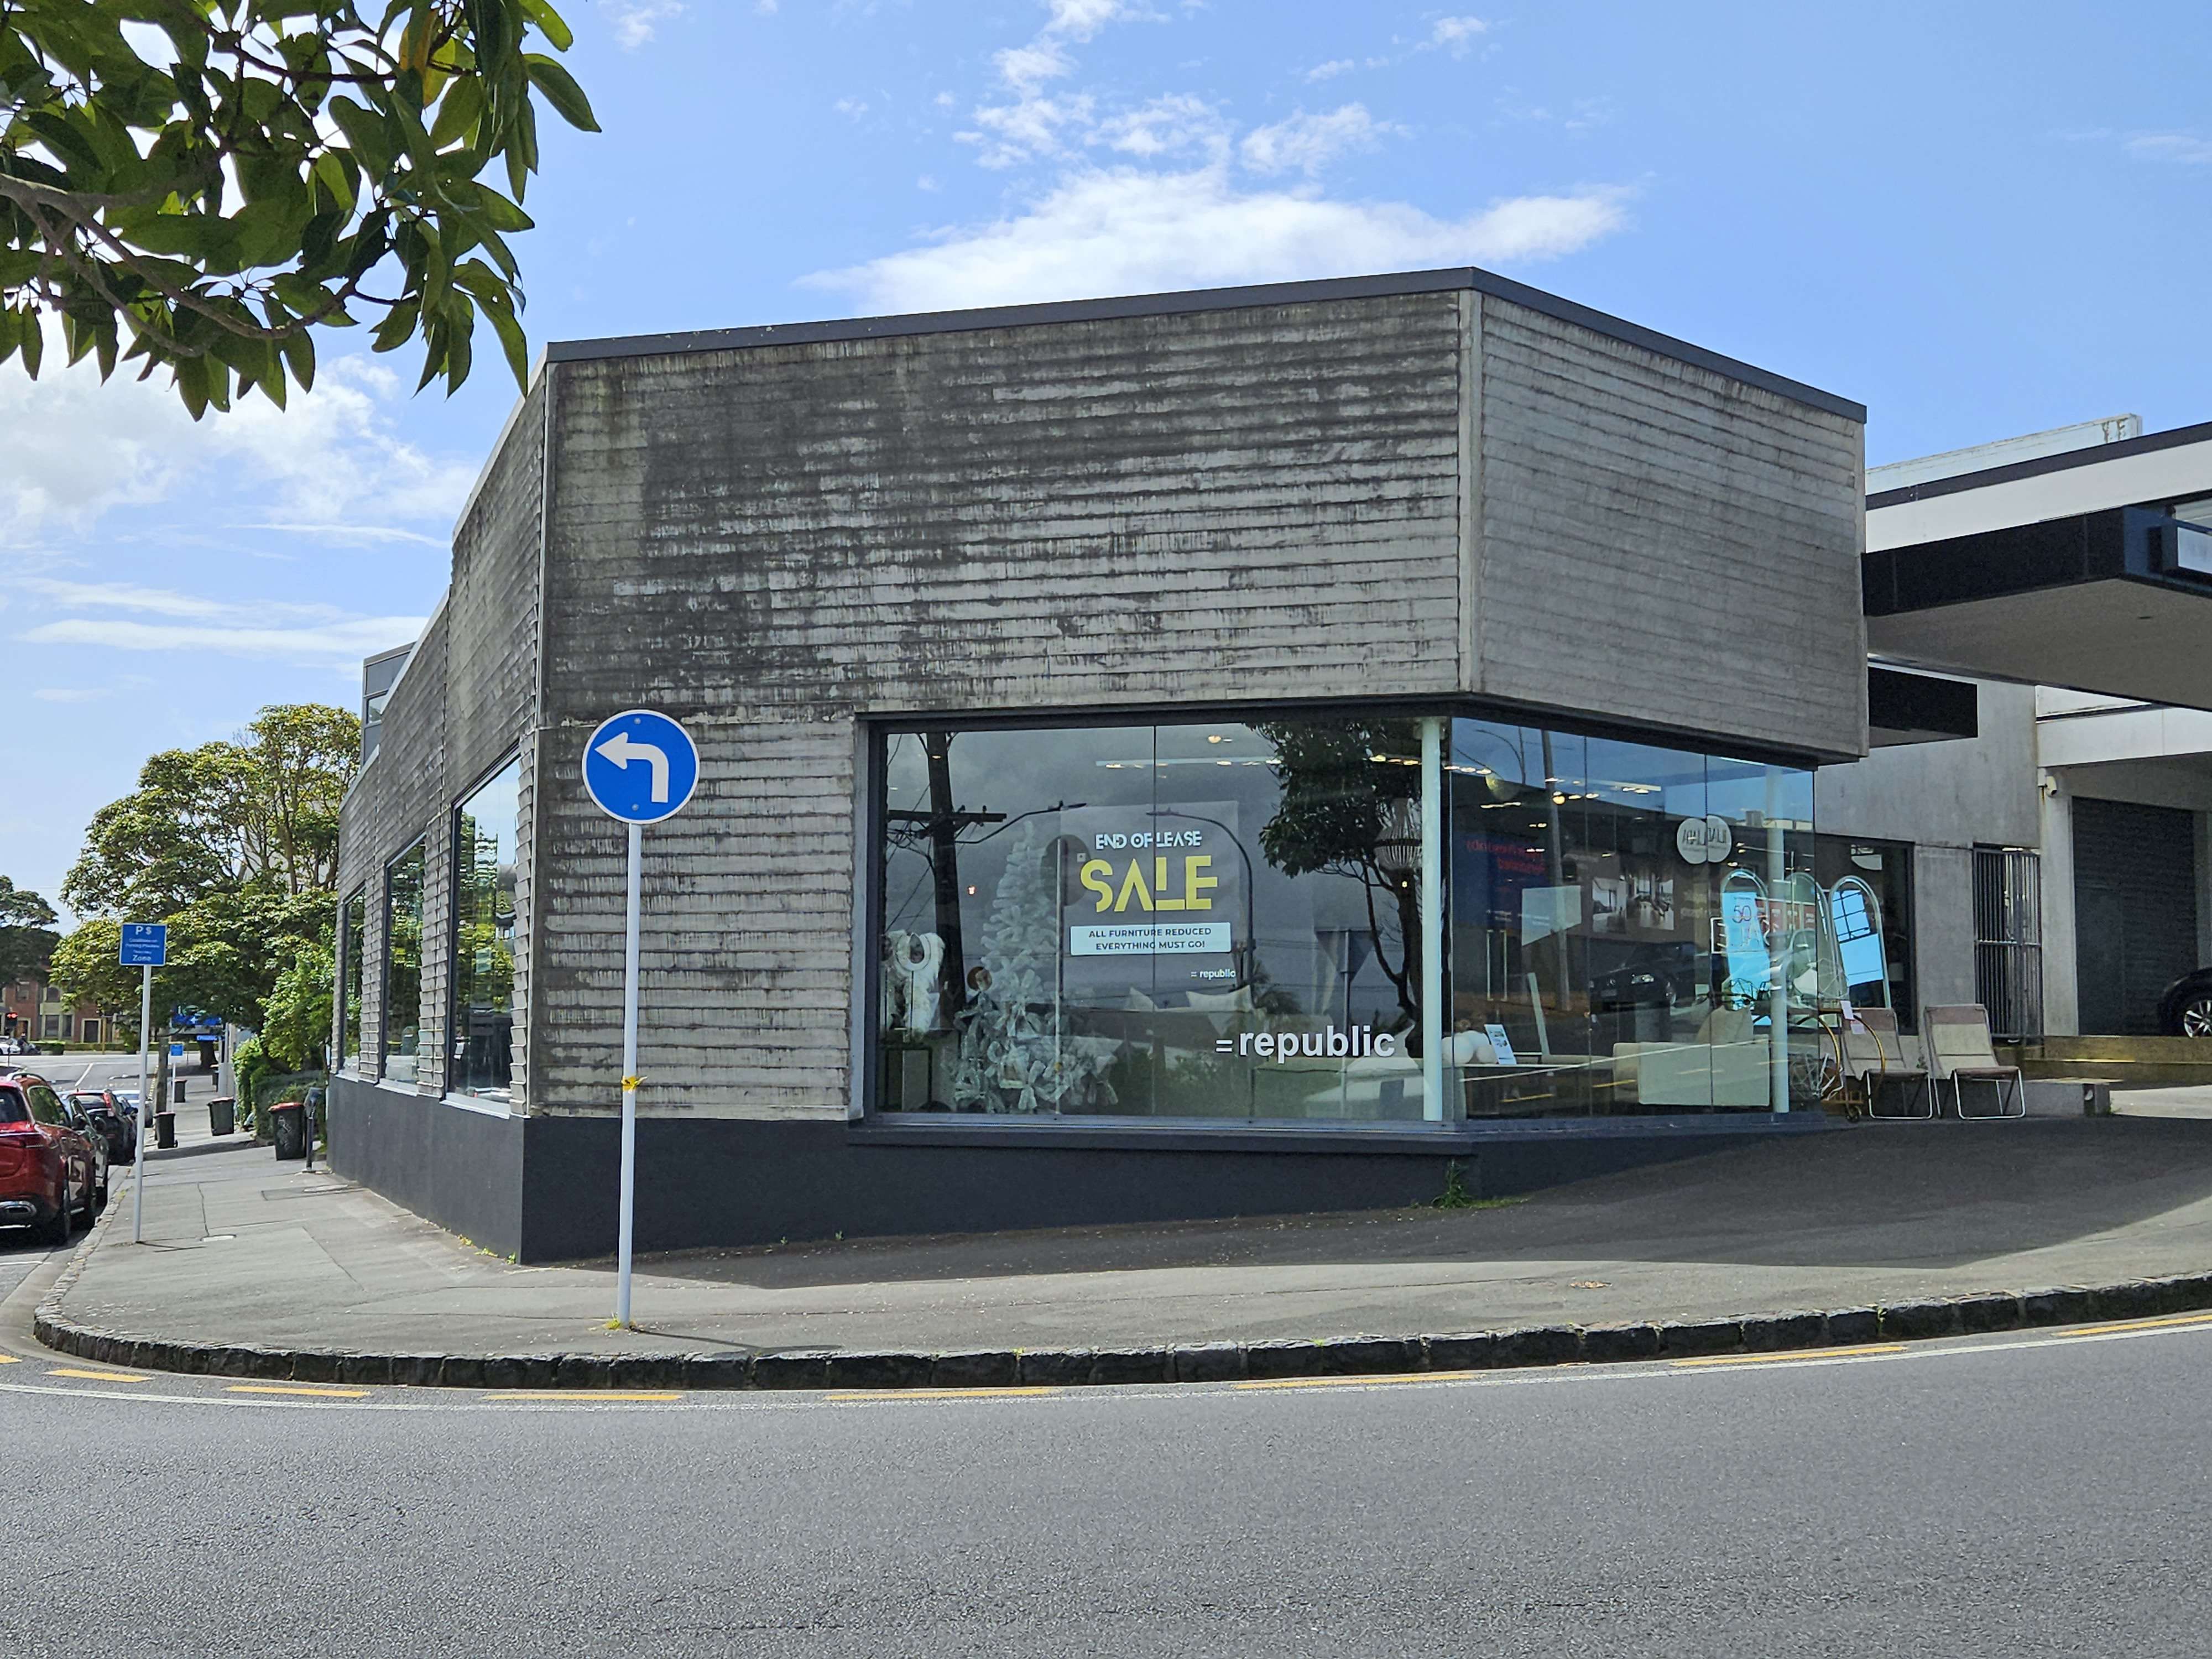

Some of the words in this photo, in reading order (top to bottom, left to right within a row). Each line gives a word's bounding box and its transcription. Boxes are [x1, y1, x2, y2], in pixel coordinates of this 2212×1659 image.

[1095, 834, 1126, 849] END
[1131, 832, 1154, 848] OF
[1156, 830, 1203, 847] LEASE
[1080, 855, 1218, 912] SALE
[1109, 928, 1162, 937] FURNITURE
